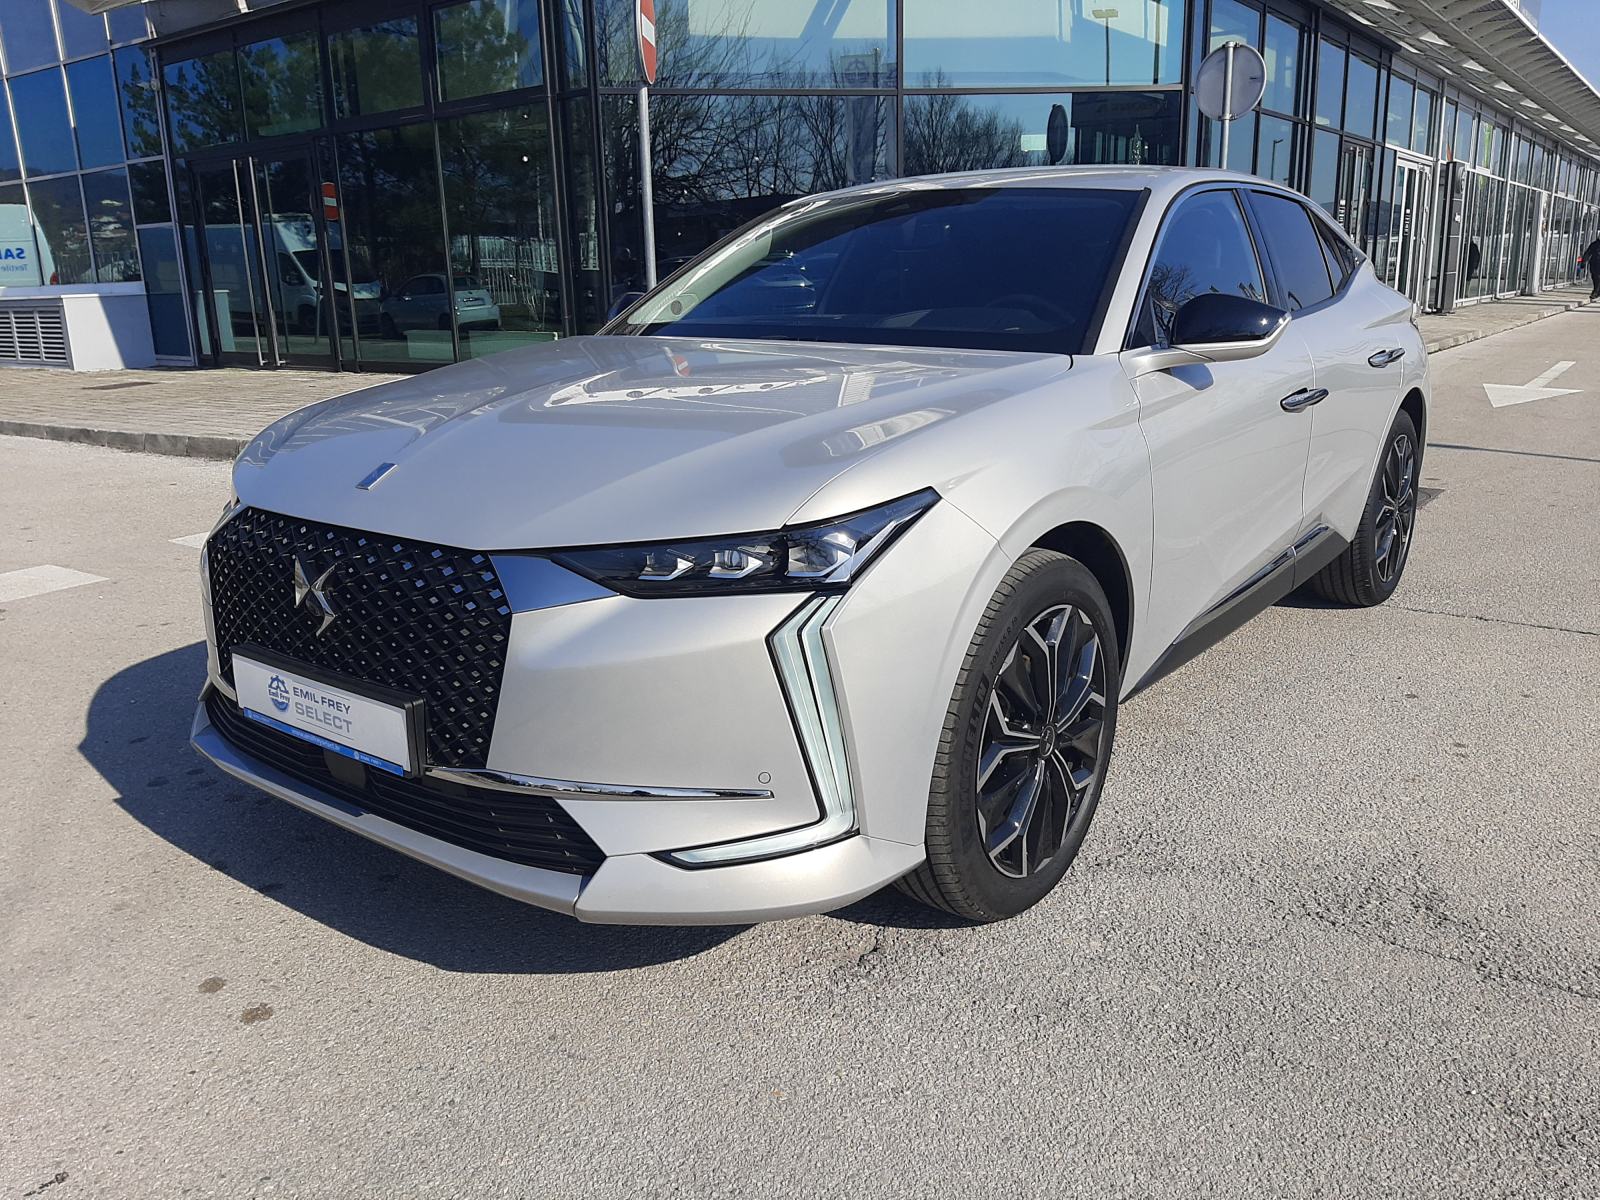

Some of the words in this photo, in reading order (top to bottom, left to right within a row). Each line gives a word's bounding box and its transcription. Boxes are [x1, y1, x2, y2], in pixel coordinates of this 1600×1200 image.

[293, 687, 319, 704] EMIL
[321, 696, 351, 714] FREY
[295, 702, 353, 733] SELECT
[959, 672, 990, 812] MICHELIN
